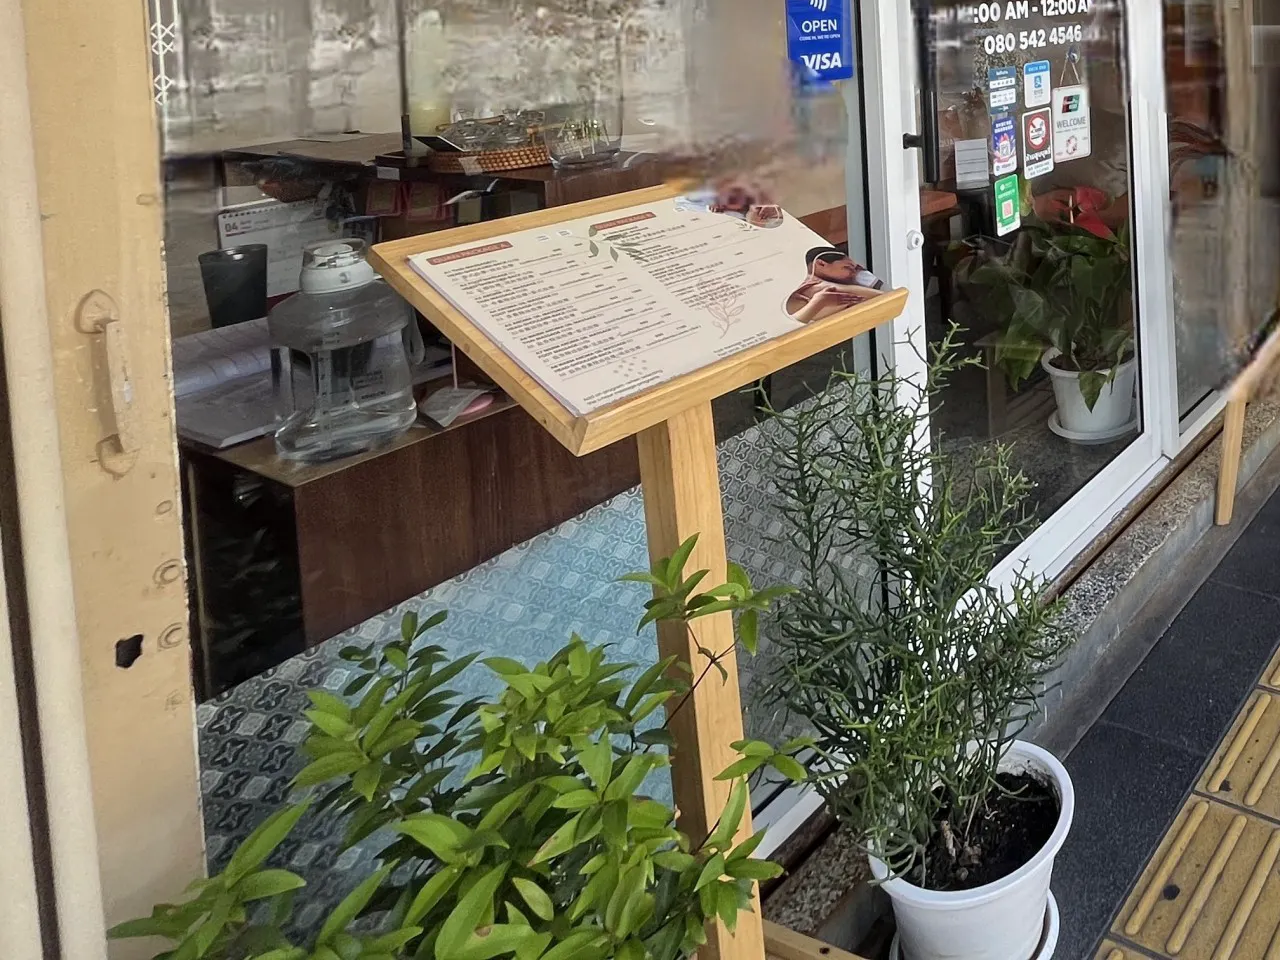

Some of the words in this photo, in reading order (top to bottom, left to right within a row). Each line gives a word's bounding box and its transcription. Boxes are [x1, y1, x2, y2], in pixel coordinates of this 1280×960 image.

[1005, 0, 1028, 20] AM
[801, 19, 838, 33] OPEN
[984, 32, 1016, 55] 080
[1019, 29, 1046, 50] 542
[1049, 24, 1082, 45] 4546
[800, 52, 842, 70] VISA
[1056, 116, 1087, 129] WELCOME
[224, 222, 239, 233] 04
